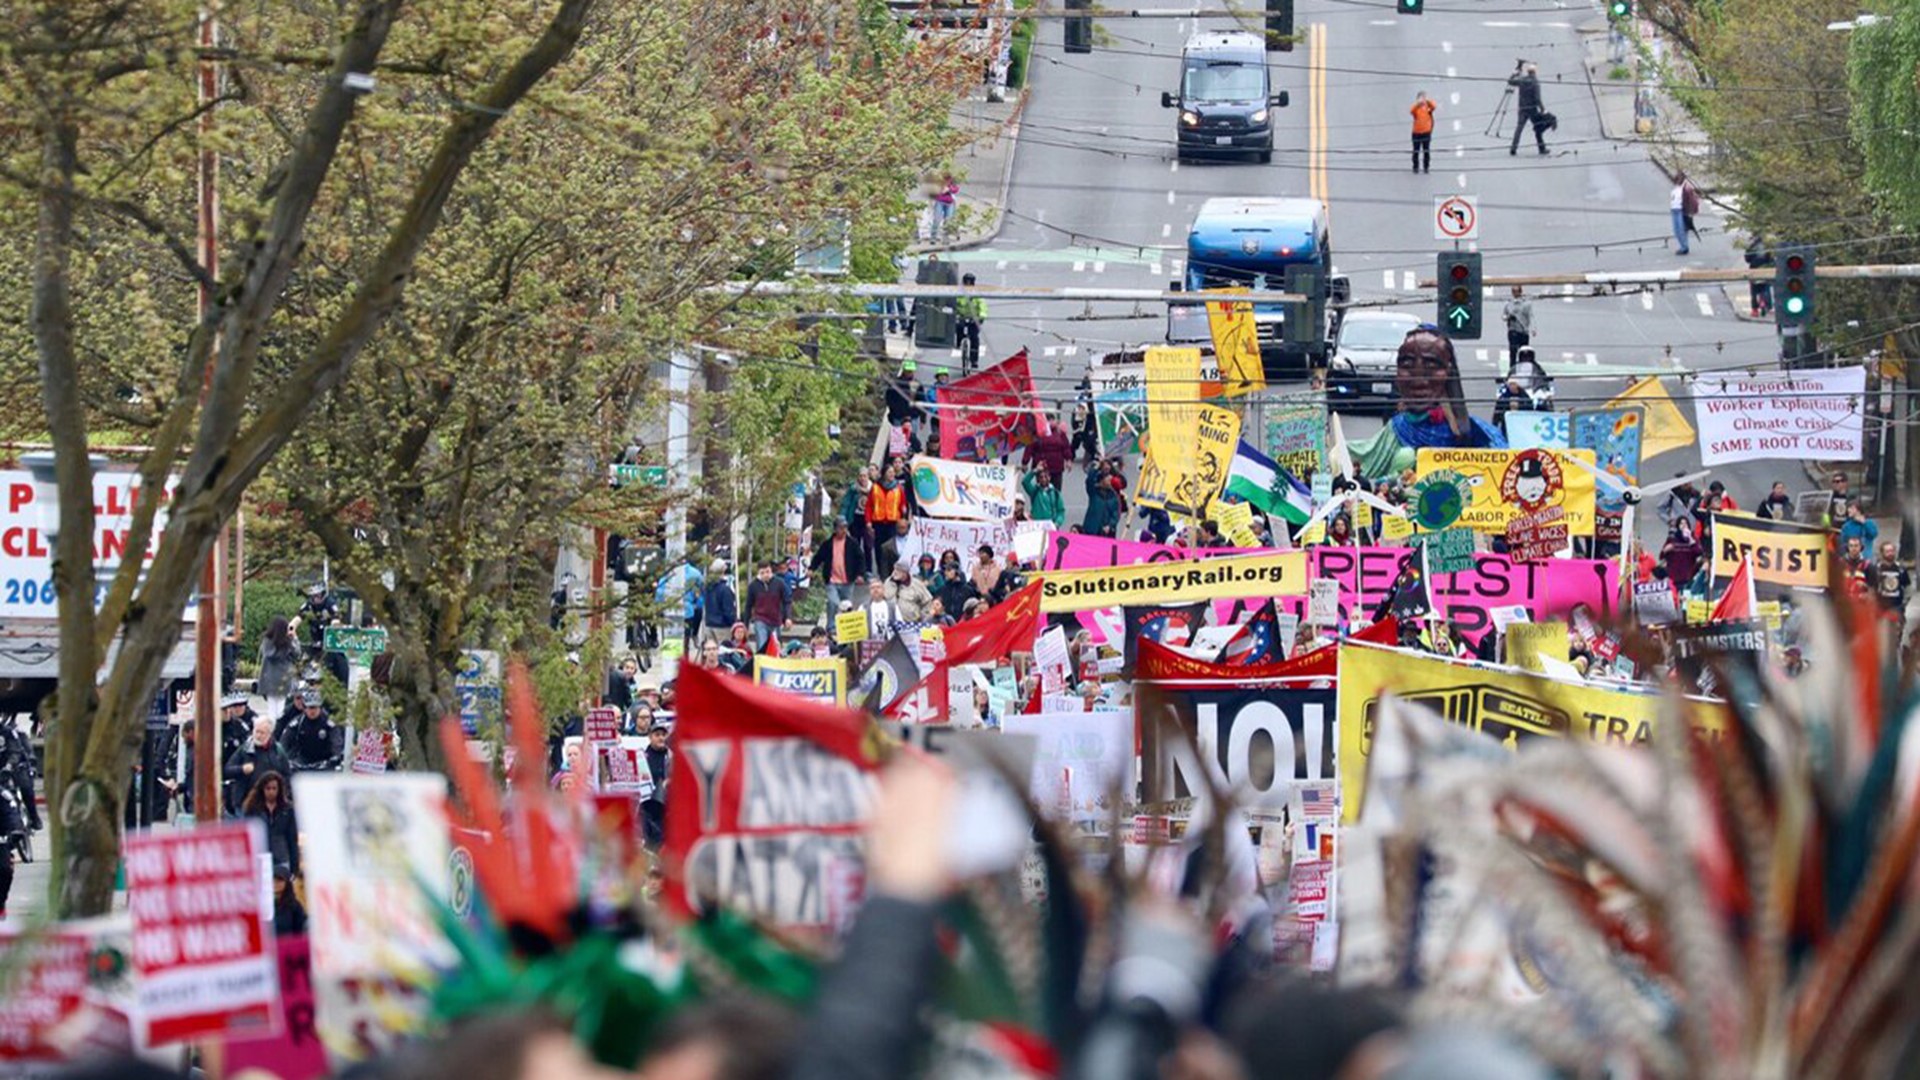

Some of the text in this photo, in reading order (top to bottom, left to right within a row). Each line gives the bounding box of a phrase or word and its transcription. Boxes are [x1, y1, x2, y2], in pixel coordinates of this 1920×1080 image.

[1707, 399, 1764, 413] Worker
[1733, 417, 1788, 430] Climate
[1711, 436, 1853, 454] SAME ROOT CAUSES
[1434, 452, 1508, 463] ORGANIZED
[1537, 450, 1561, 485] TRADE
[975, 466, 1006, 481] LIVES
[1503, 462, 1521, 497] FREE
[1460, 511, 1505, 521] LABOR
[914, 520, 934, 541] WE
[939, 525, 959, 543] ARE
[1722, 538, 1821, 572] RESIST
[1043, 565, 1283, 597] SolutionaryRail.org
[1499, 701, 1552, 726] SEATTLE
